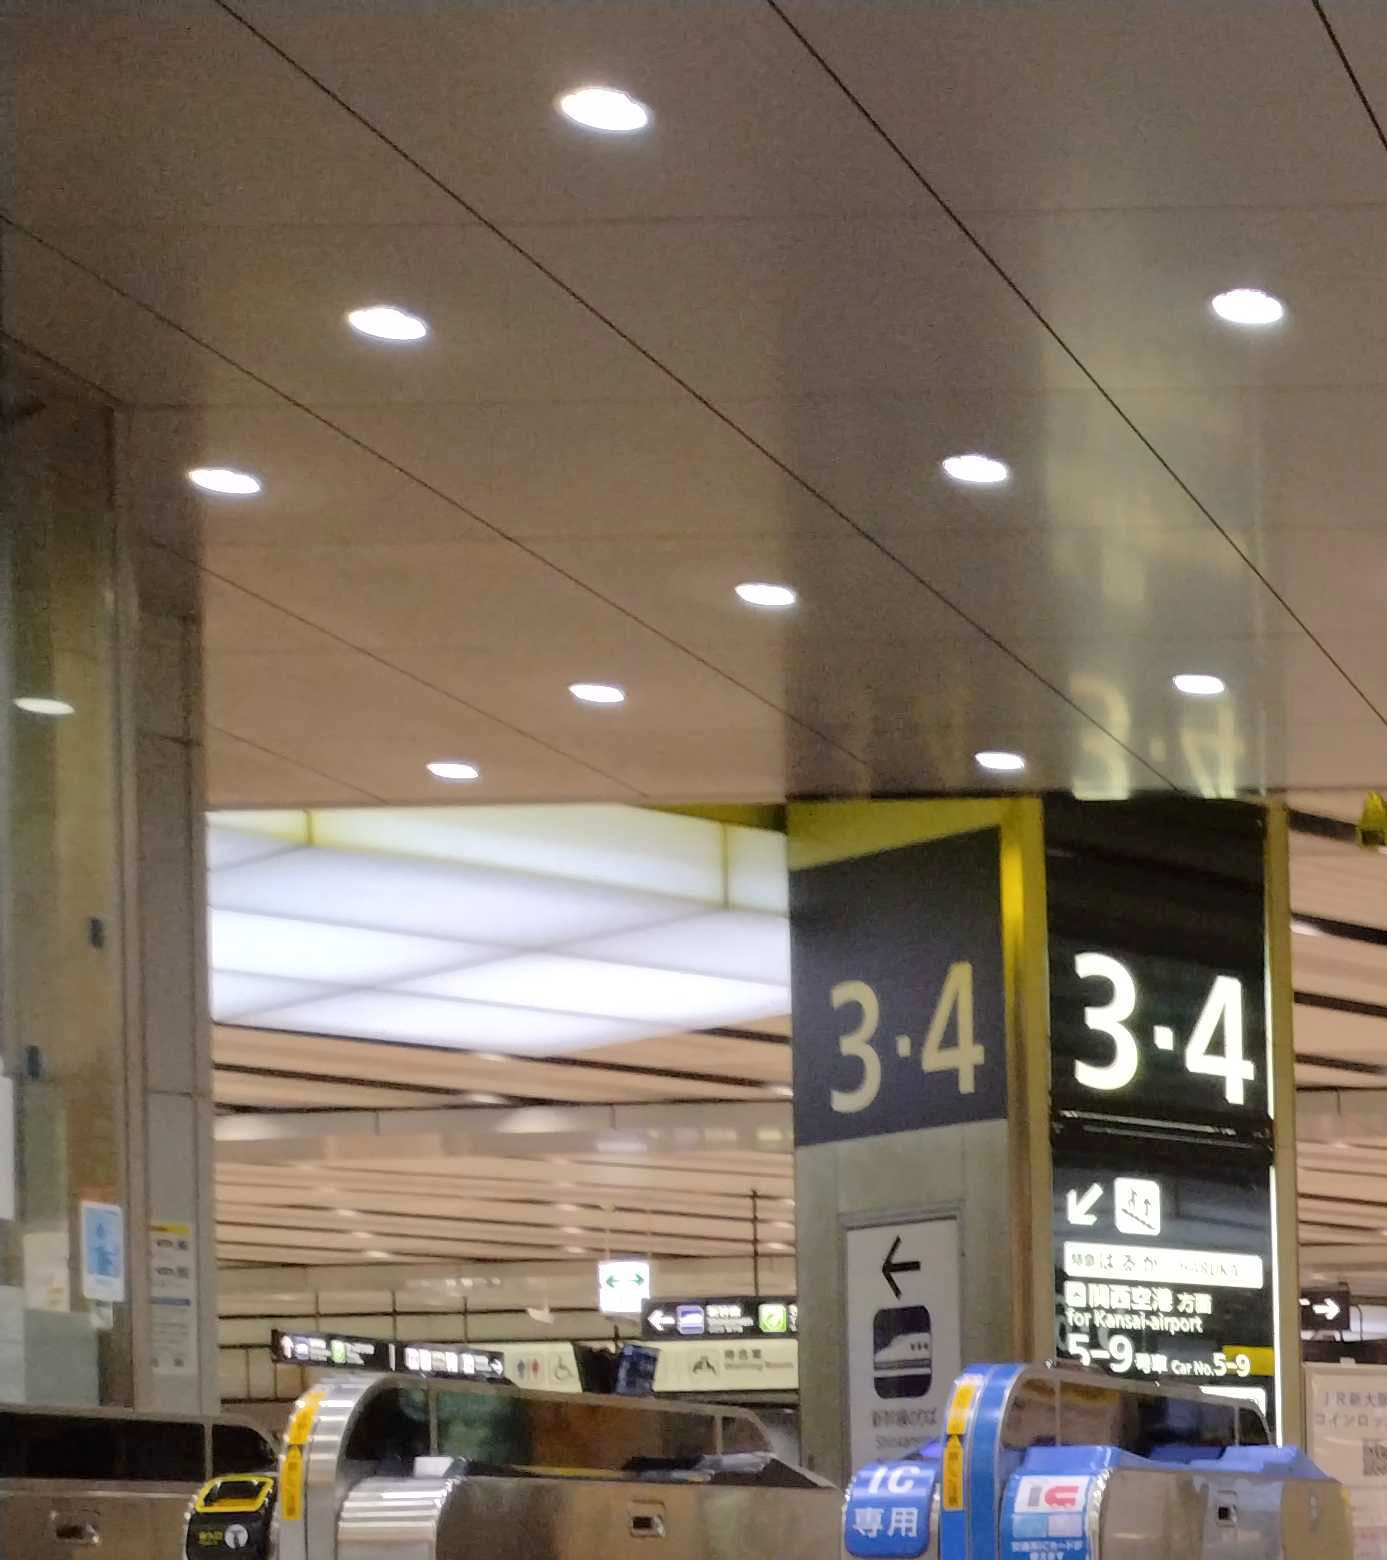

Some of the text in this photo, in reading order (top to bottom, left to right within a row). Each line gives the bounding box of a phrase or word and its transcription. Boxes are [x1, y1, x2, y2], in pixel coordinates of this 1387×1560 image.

[1066, 1309, 1090, 1327] for
[869, 1465, 921, 1494] IC
[853, 1507, 918, 1538] 専用
